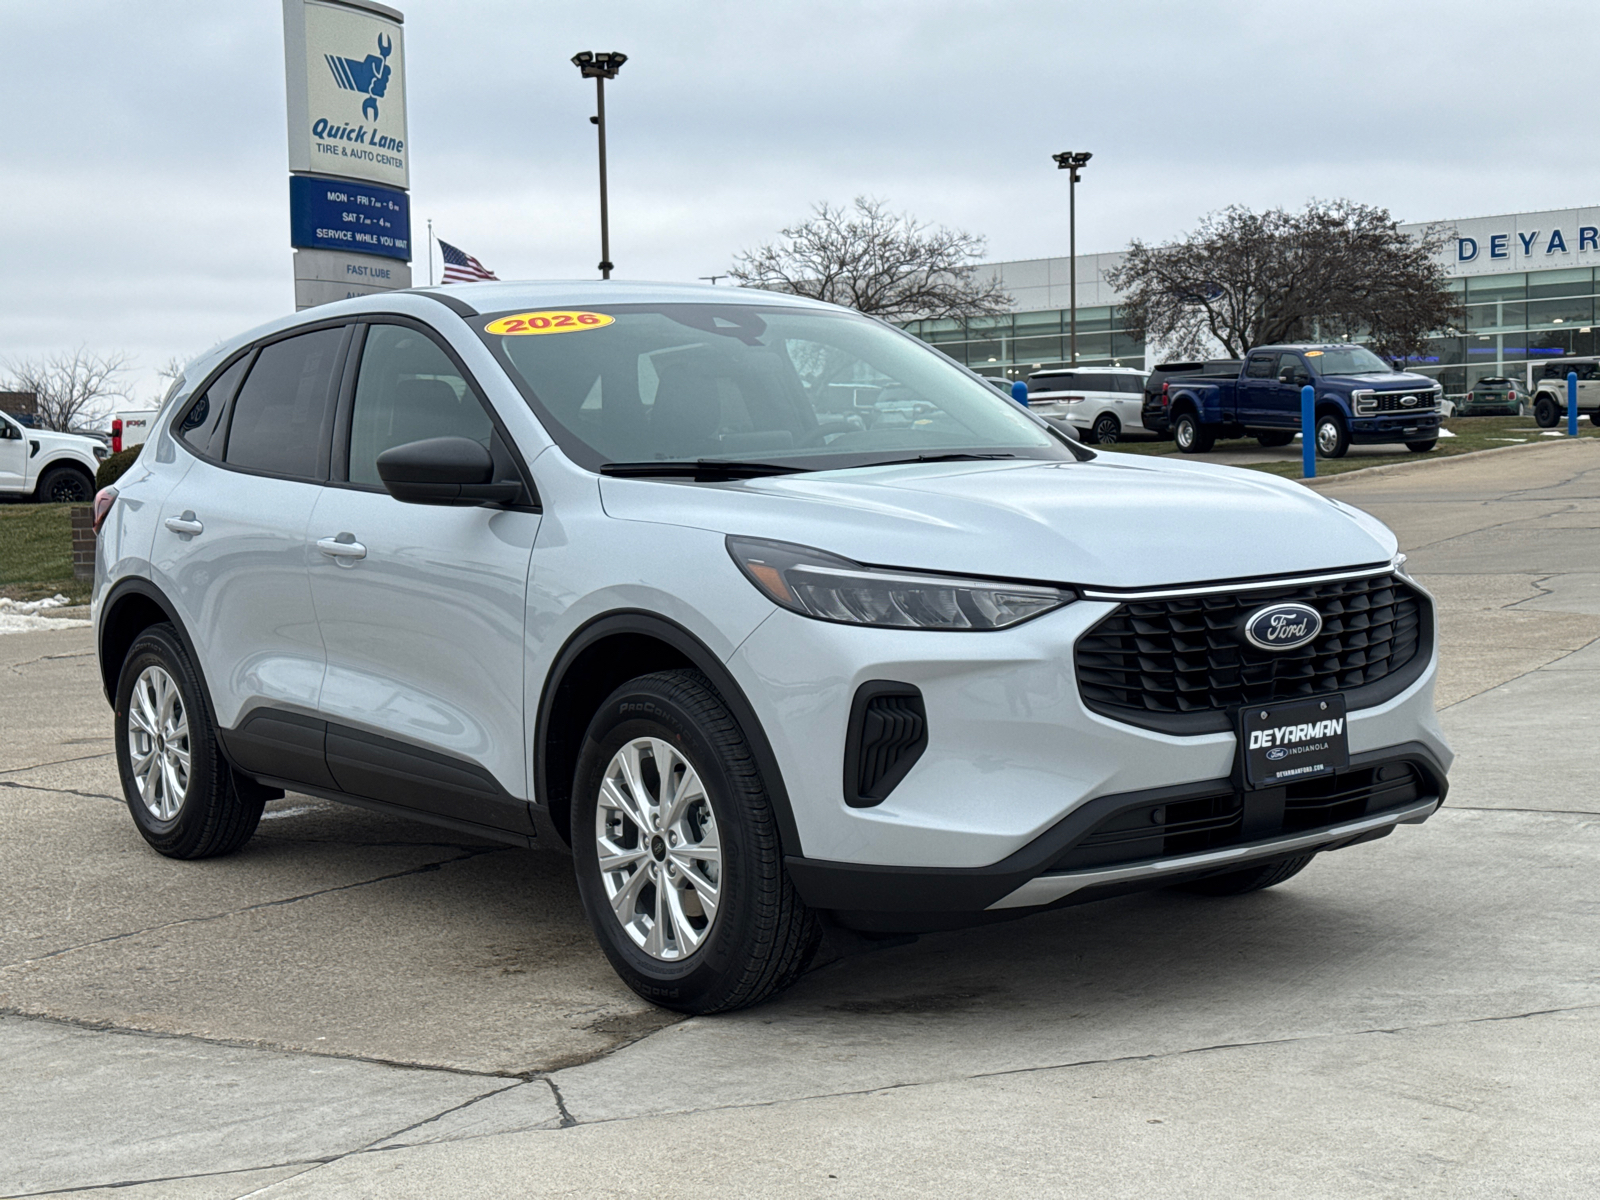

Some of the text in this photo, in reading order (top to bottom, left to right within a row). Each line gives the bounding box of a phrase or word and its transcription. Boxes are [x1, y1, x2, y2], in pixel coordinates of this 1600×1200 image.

[312, 117, 404, 153] Quick Lane
[316, 143, 404, 169] TIRE & AUTO CENTER
[327, 191, 347, 203] MON
[357, 195, 369, 206] FRI
[342, 212, 357, 222] SAT
[316, 228, 408, 249] SERVICE WHILE YOU WAIT
[1457, 226, 1600, 263] DEYAR
[346, 264, 391, 279] FAST LUBE
[502, 314, 601, 333] 2026
[1267, 613, 1308, 640] Ford
[1249, 718, 1344, 750] DEYARMAN
[1289, 742, 1329, 755] INDIANOLA
[1276, 763, 1325, 778] DEYARMANFORD.COM
